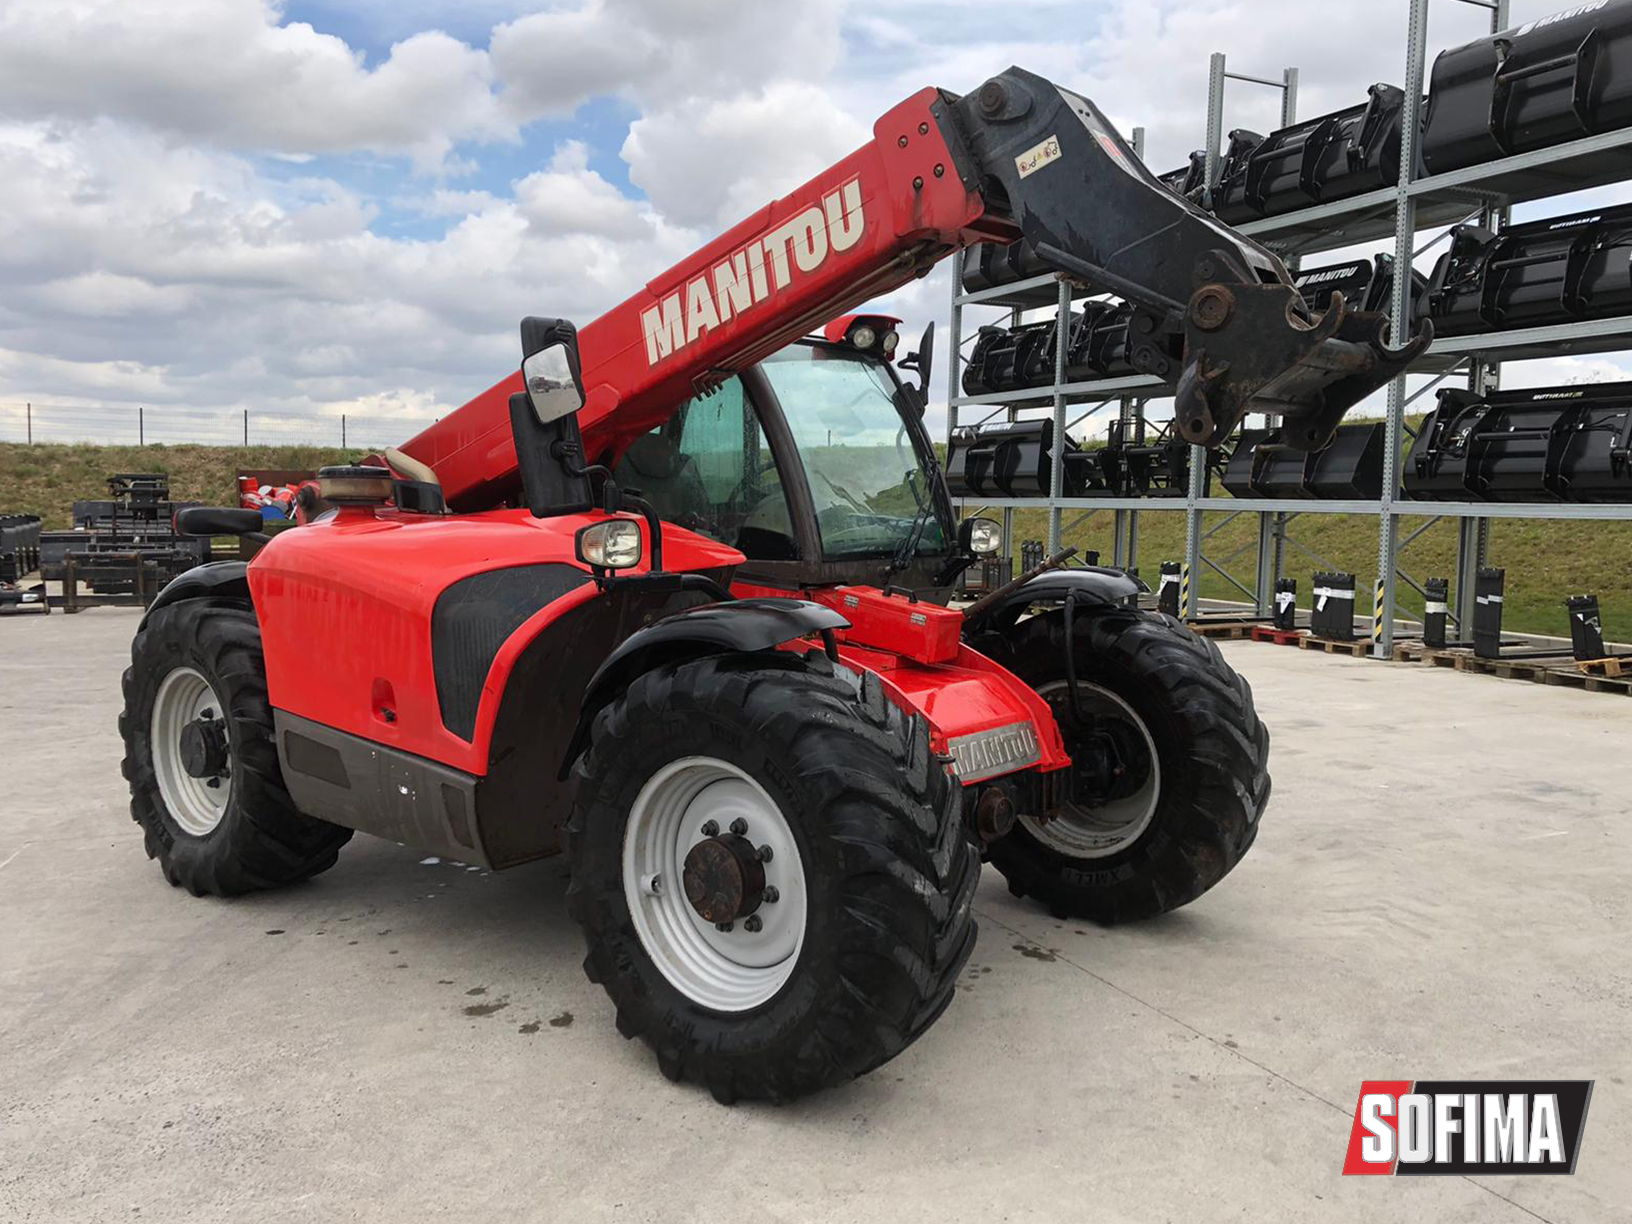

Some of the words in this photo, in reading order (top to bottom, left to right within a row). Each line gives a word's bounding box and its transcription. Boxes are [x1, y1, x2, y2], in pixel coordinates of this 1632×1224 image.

[642, 178, 865, 366] MANITOU
[1306, 266, 1359, 285] MANITOU
[949, 728, 1037, 775] MANITOU
